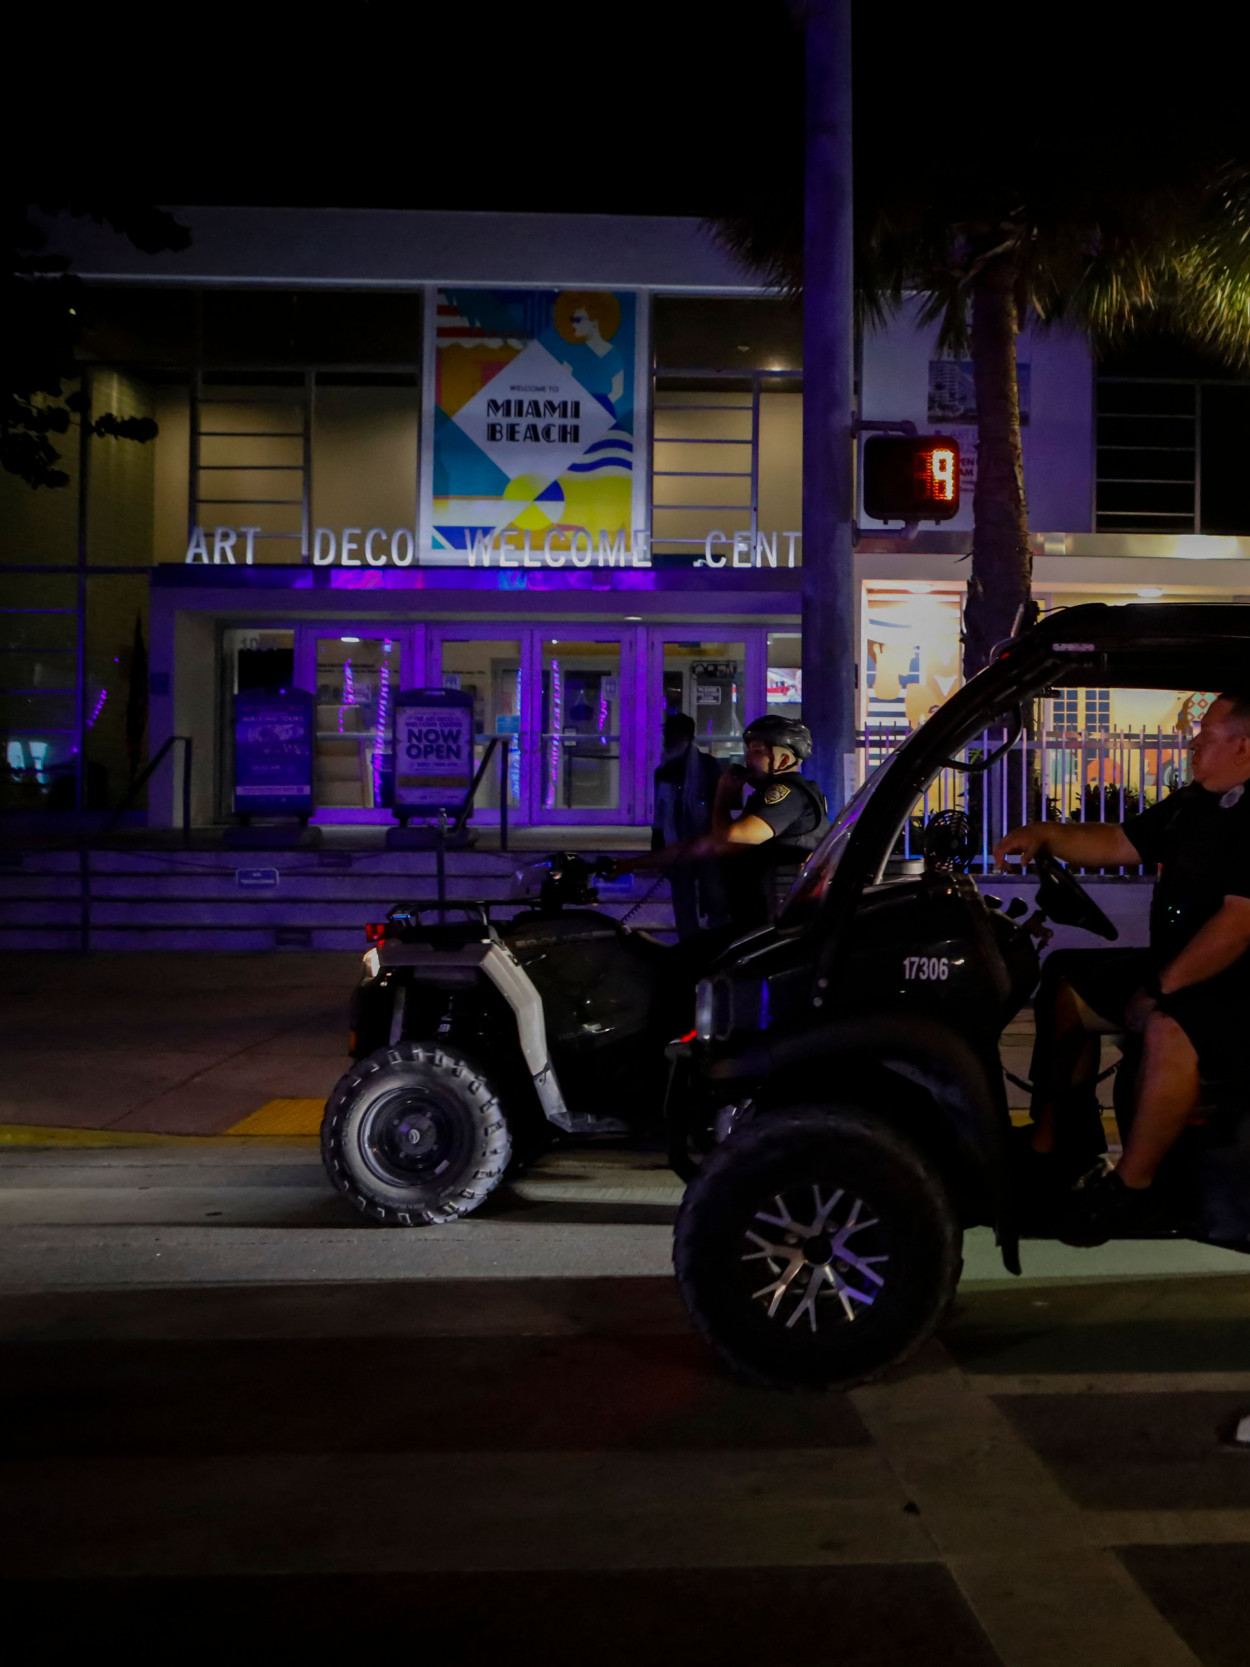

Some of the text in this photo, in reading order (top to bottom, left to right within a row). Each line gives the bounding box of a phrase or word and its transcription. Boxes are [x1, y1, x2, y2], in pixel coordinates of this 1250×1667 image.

[509, 384, 546, 392] WELCOME
[486, 399, 580, 418] MIAMI
[486, 422, 580, 443] BEACH
[931, 449, 955, 501] 9
[184, 526, 803, 568] ART DECO WELCOME CENT
[408, 729, 461, 743] NOW
[407, 744, 460, 759] OPEN
[903, 957, 949, 980] 17306
